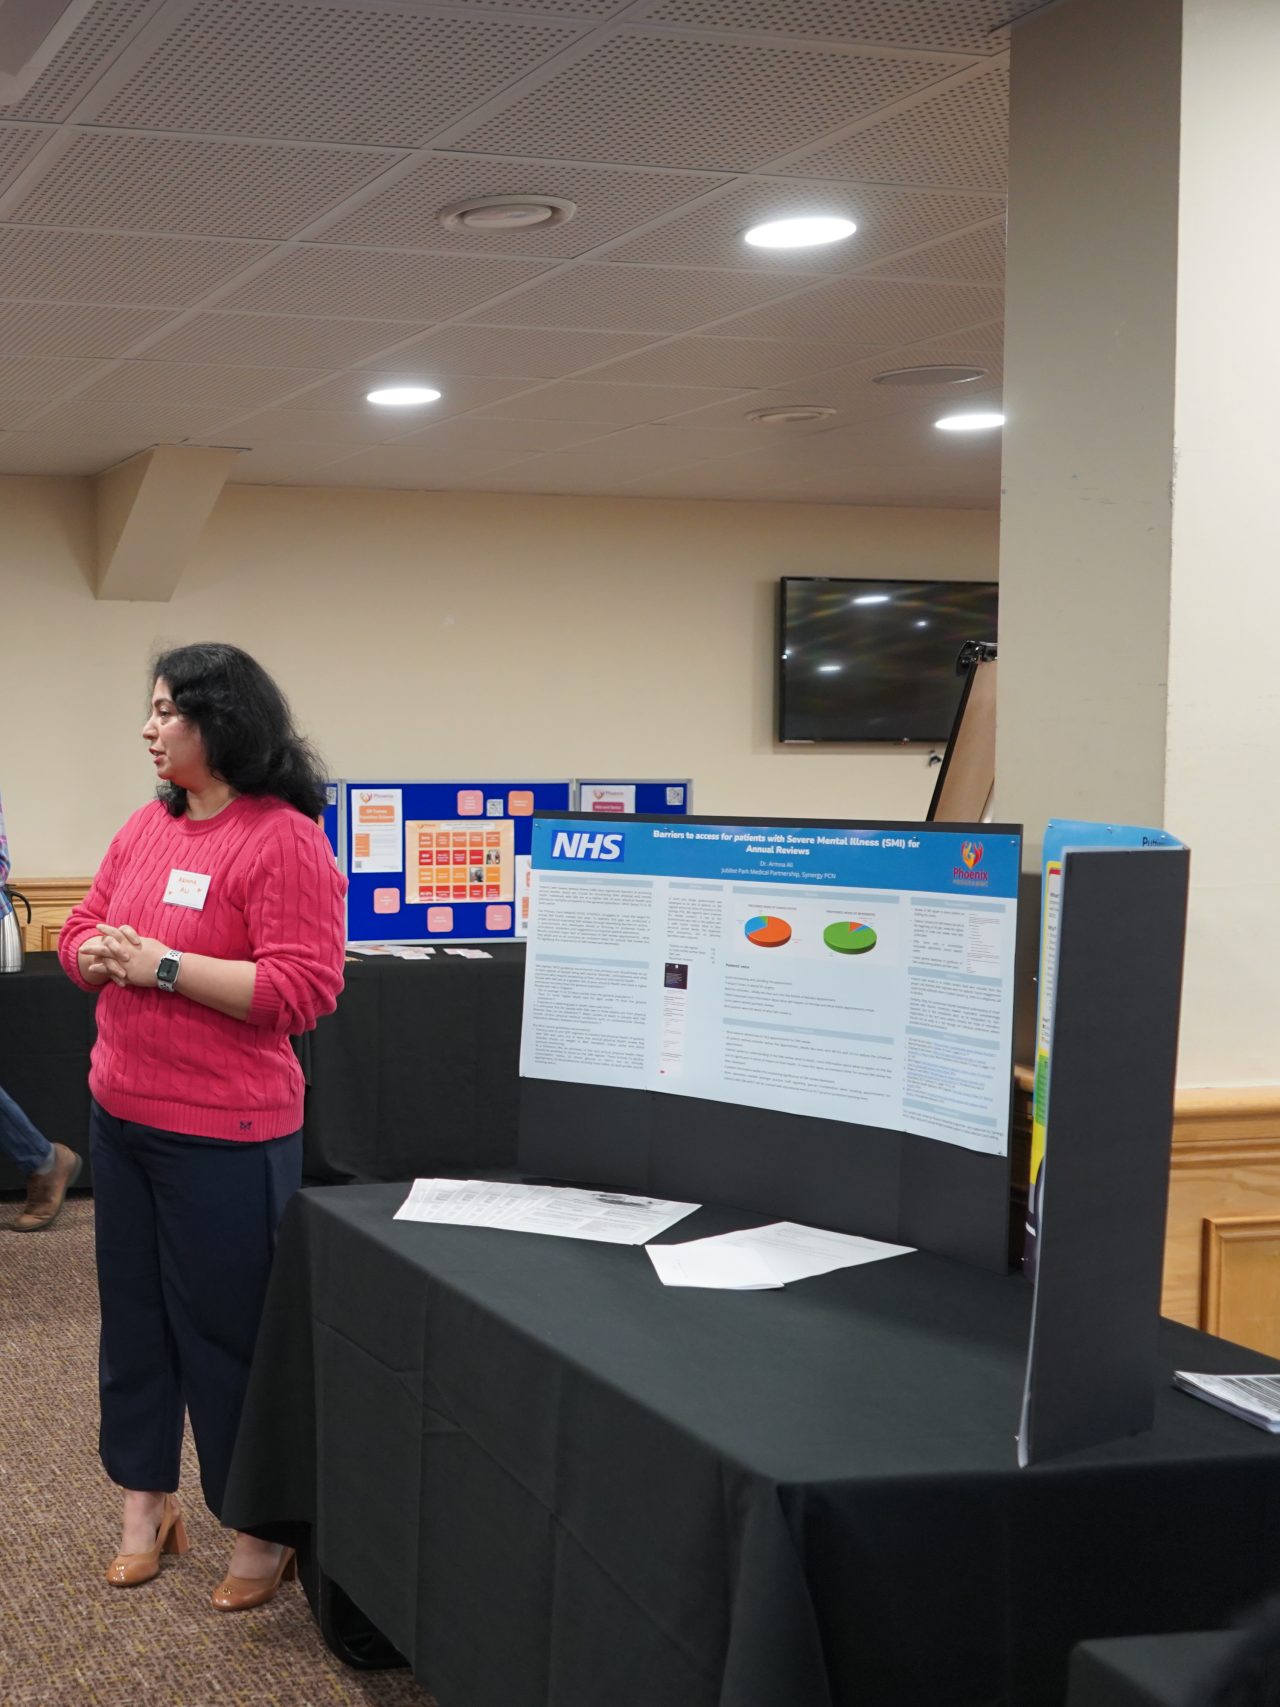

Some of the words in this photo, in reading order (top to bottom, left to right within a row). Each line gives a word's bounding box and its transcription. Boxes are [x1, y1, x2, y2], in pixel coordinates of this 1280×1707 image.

[552, 832, 623, 860] NHS
[653, 830, 684, 839] Barriers
[686, 831, 694, 840] to
[721, 832, 733, 841] for
[733, 833, 765, 843] patients
[767, 834, 785, 843] with
[787, 835, 814, 844] Severe
[817, 836, 848, 846] Mental
[850, 837, 879, 847] Illness
[881, 838, 905, 849] (SMI)
[908, 839, 920, 848] for
[746, 844, 774, 854] Annual
[776, 845, 810, 855] Reviews
[750, 868, 769, 876] Medical
[801, 871, 823, 880] Synergy
[953, 867, 989, 881] Phoenix
